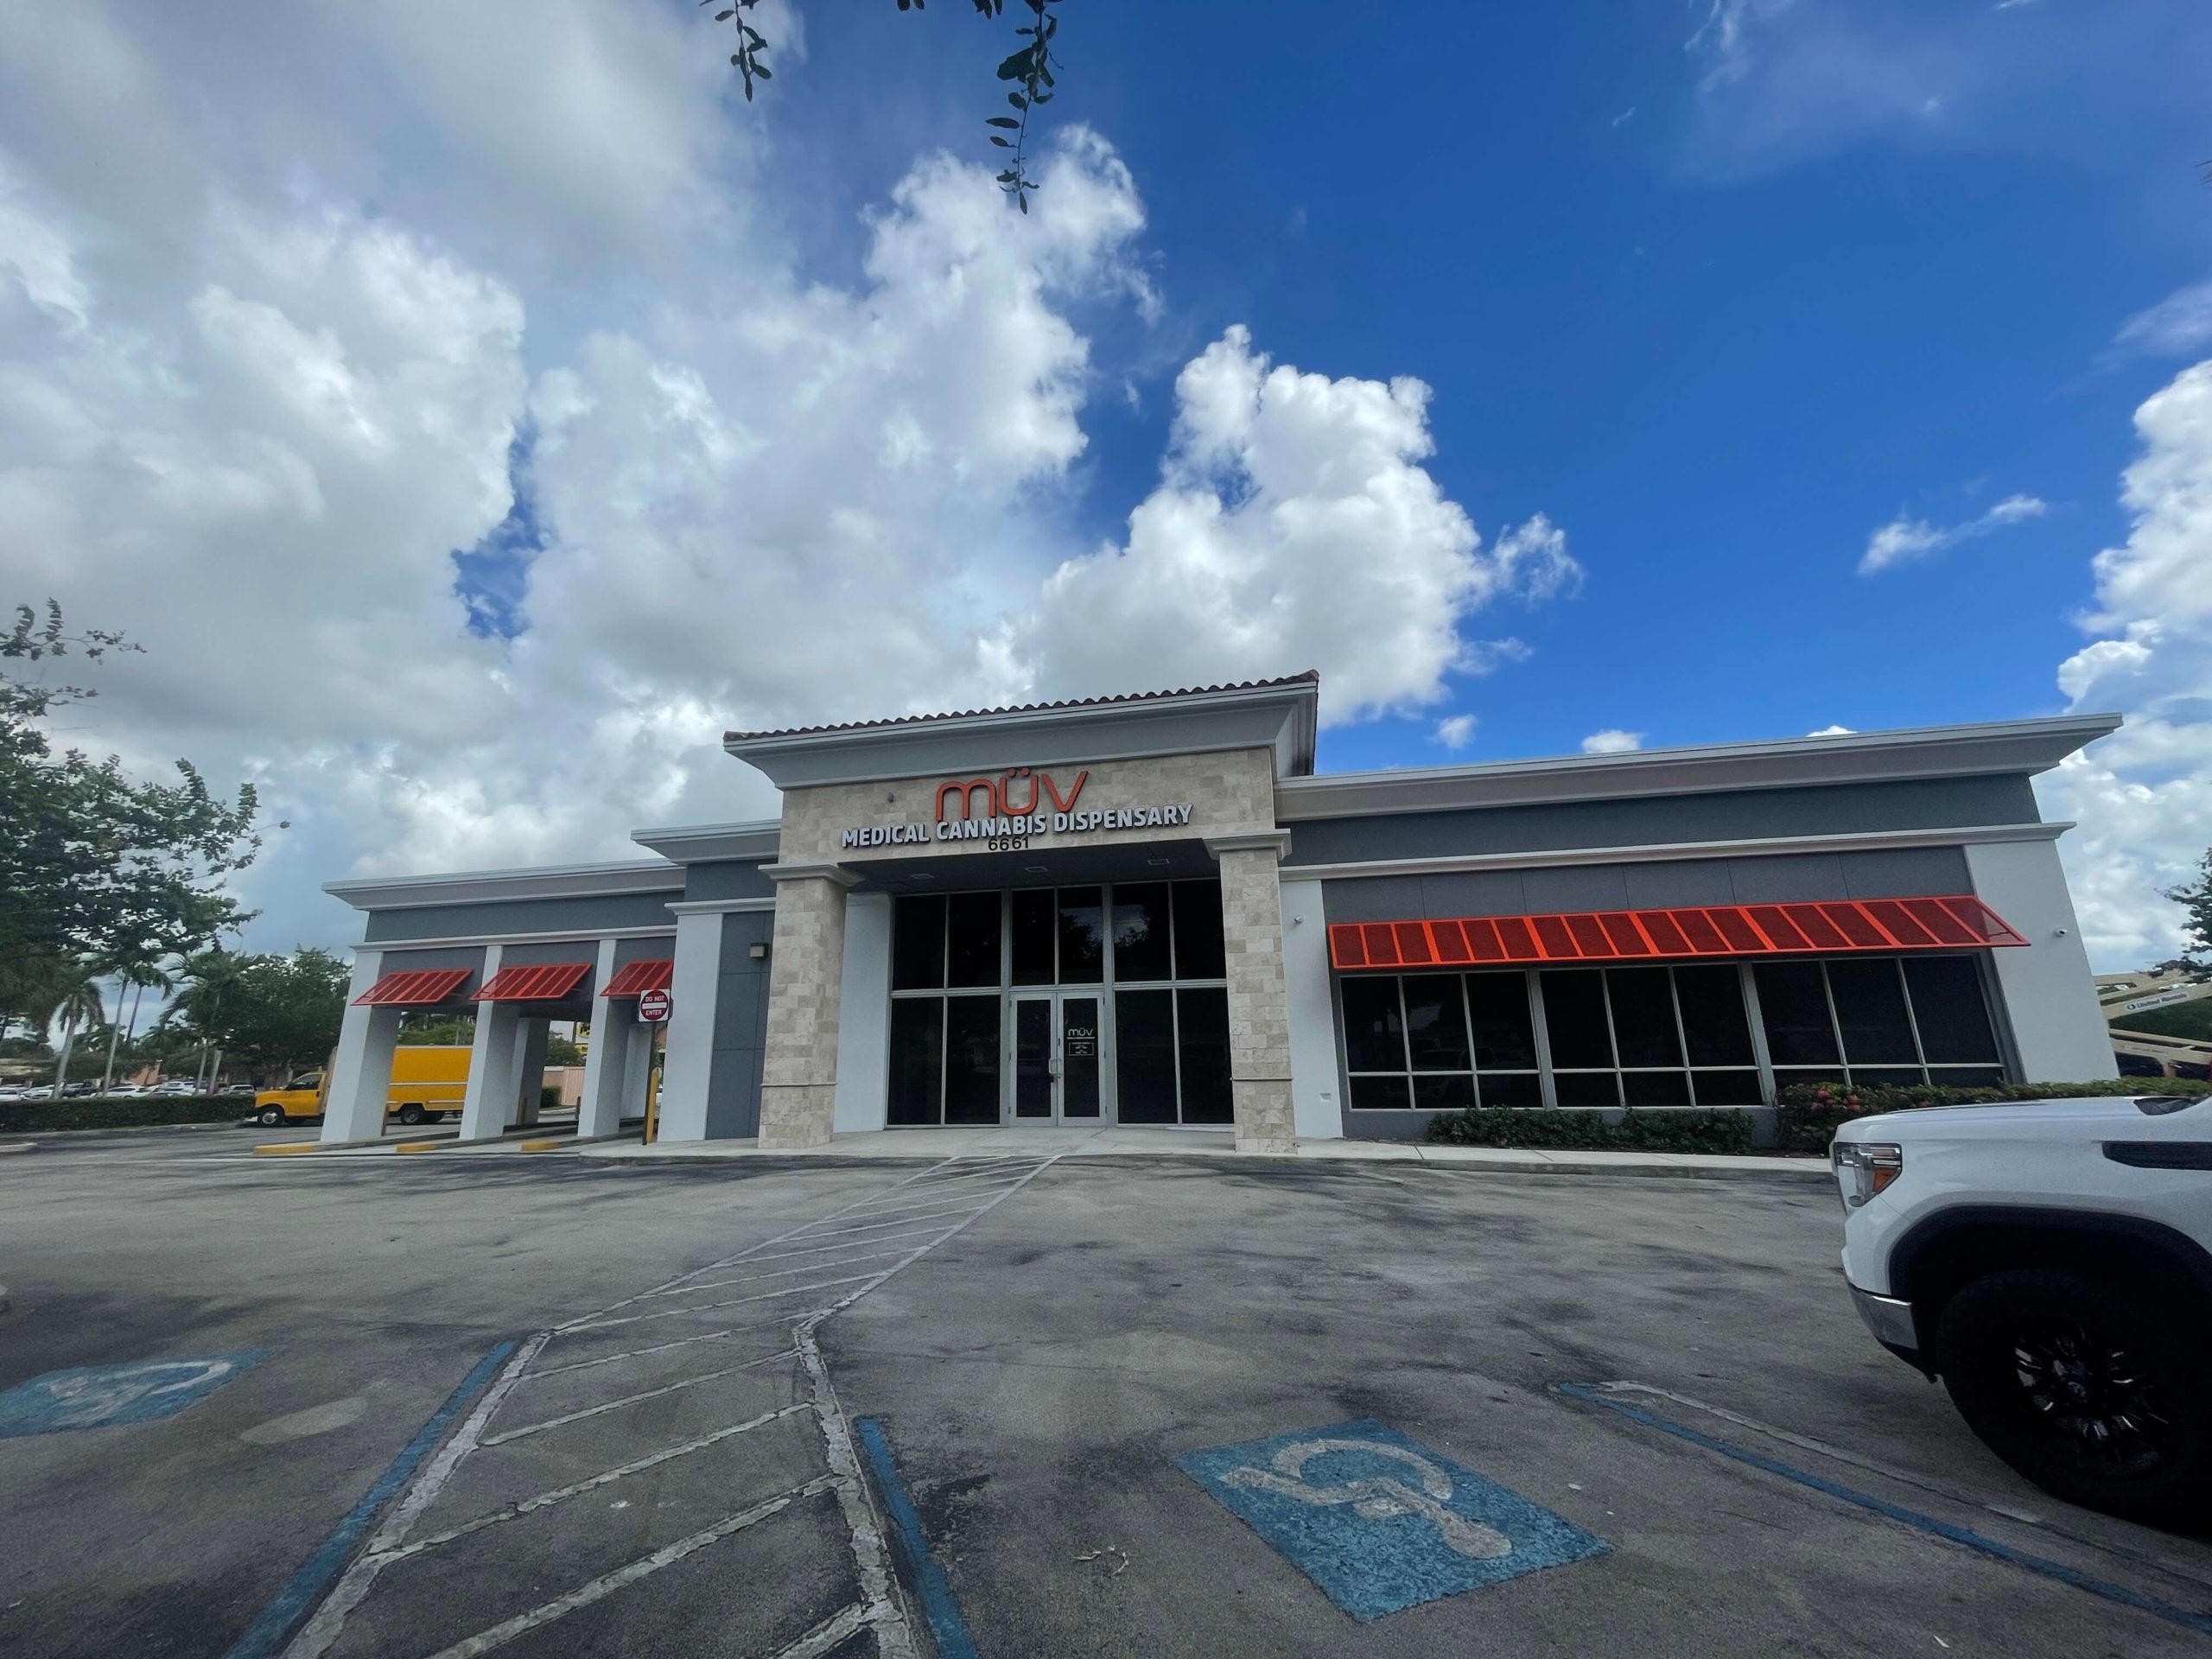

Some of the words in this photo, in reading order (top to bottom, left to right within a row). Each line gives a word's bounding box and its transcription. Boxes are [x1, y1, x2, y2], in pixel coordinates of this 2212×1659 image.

[842, 823, 931, 849] MEDICAL
[936, 814, 1046, 841] CANNABIS
[1054, 804, 1193, 833] DISPENSARY
[988, 836, 1029, 851] 6661
